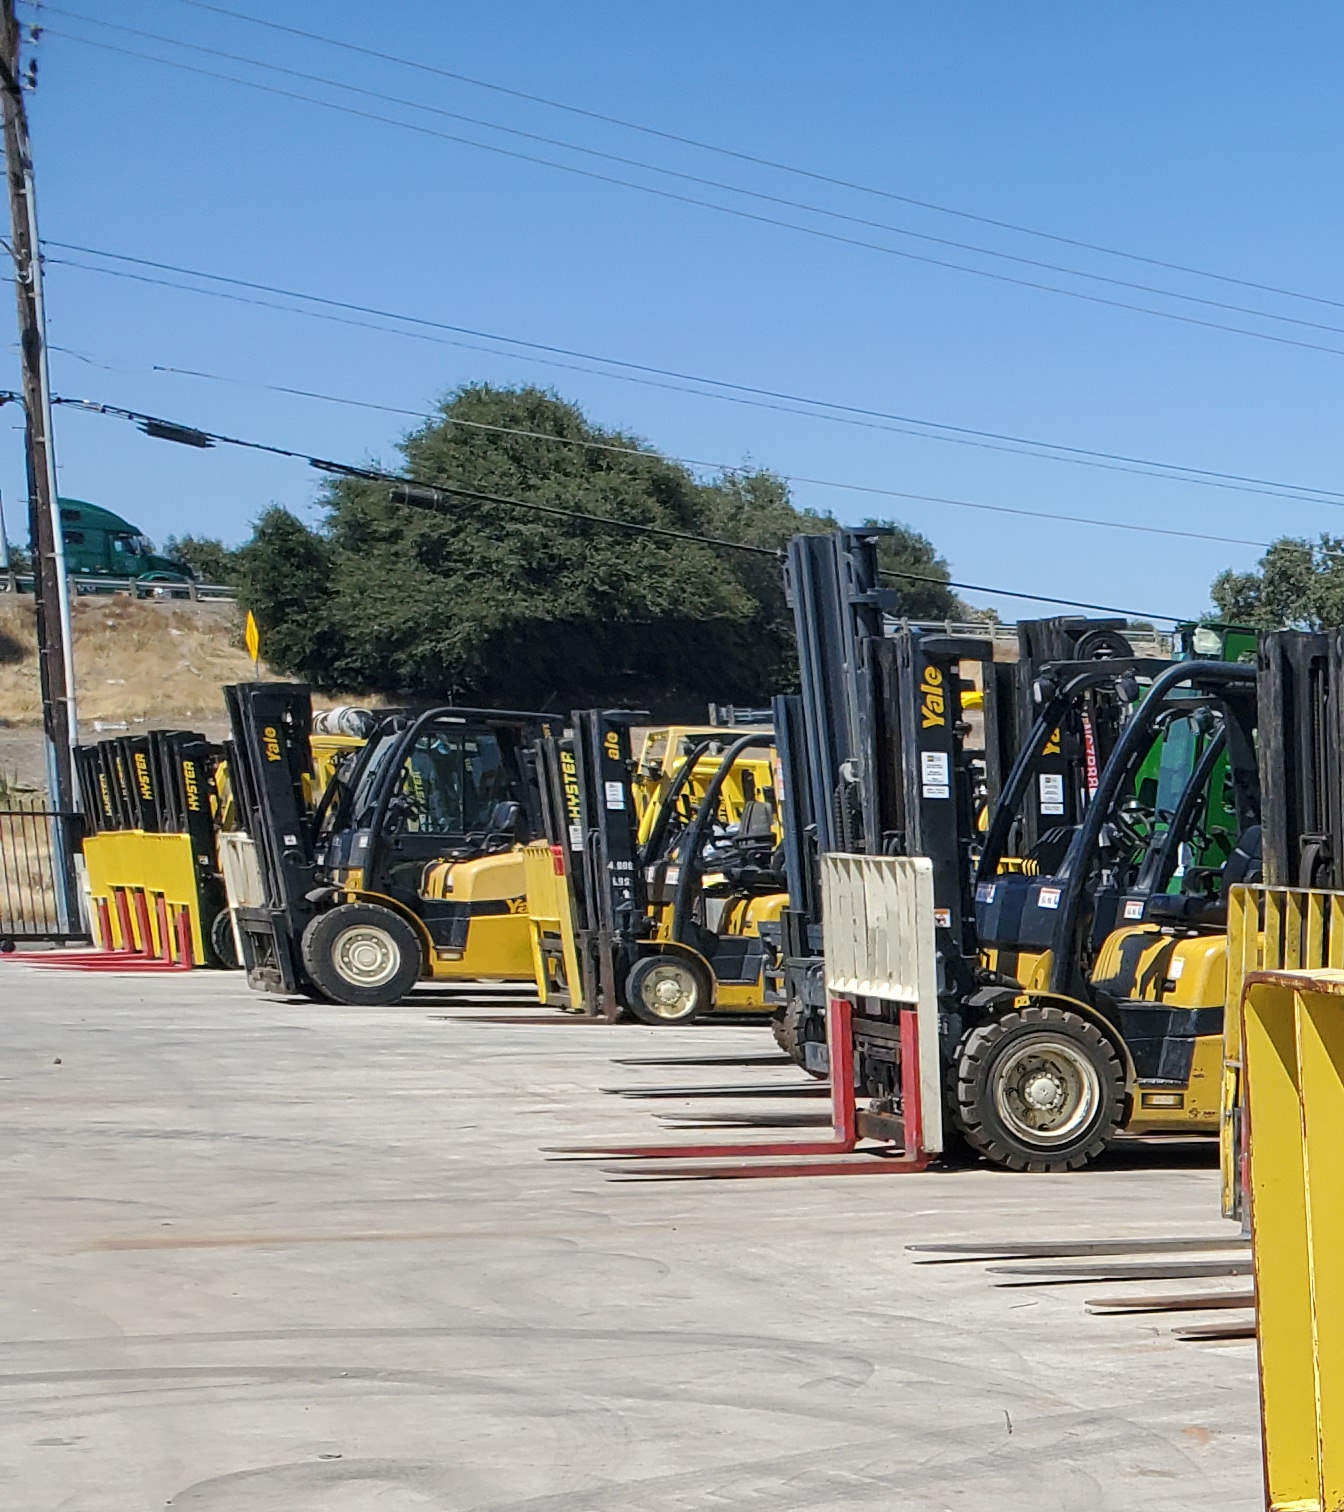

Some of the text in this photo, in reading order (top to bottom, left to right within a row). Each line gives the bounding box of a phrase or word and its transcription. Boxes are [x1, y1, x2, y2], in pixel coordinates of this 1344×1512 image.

[920, 665, 945, 728] Yale
[263, 726, 282, 762] Yale
[1042, 727, 1060, 755] Ya
[134, 753, 153, 800] HYSTER
[183, 760, 201, 811] HYSTER
[560, 751, 582, 821] HYSTER
[506, 899, 528, 914] Ya
